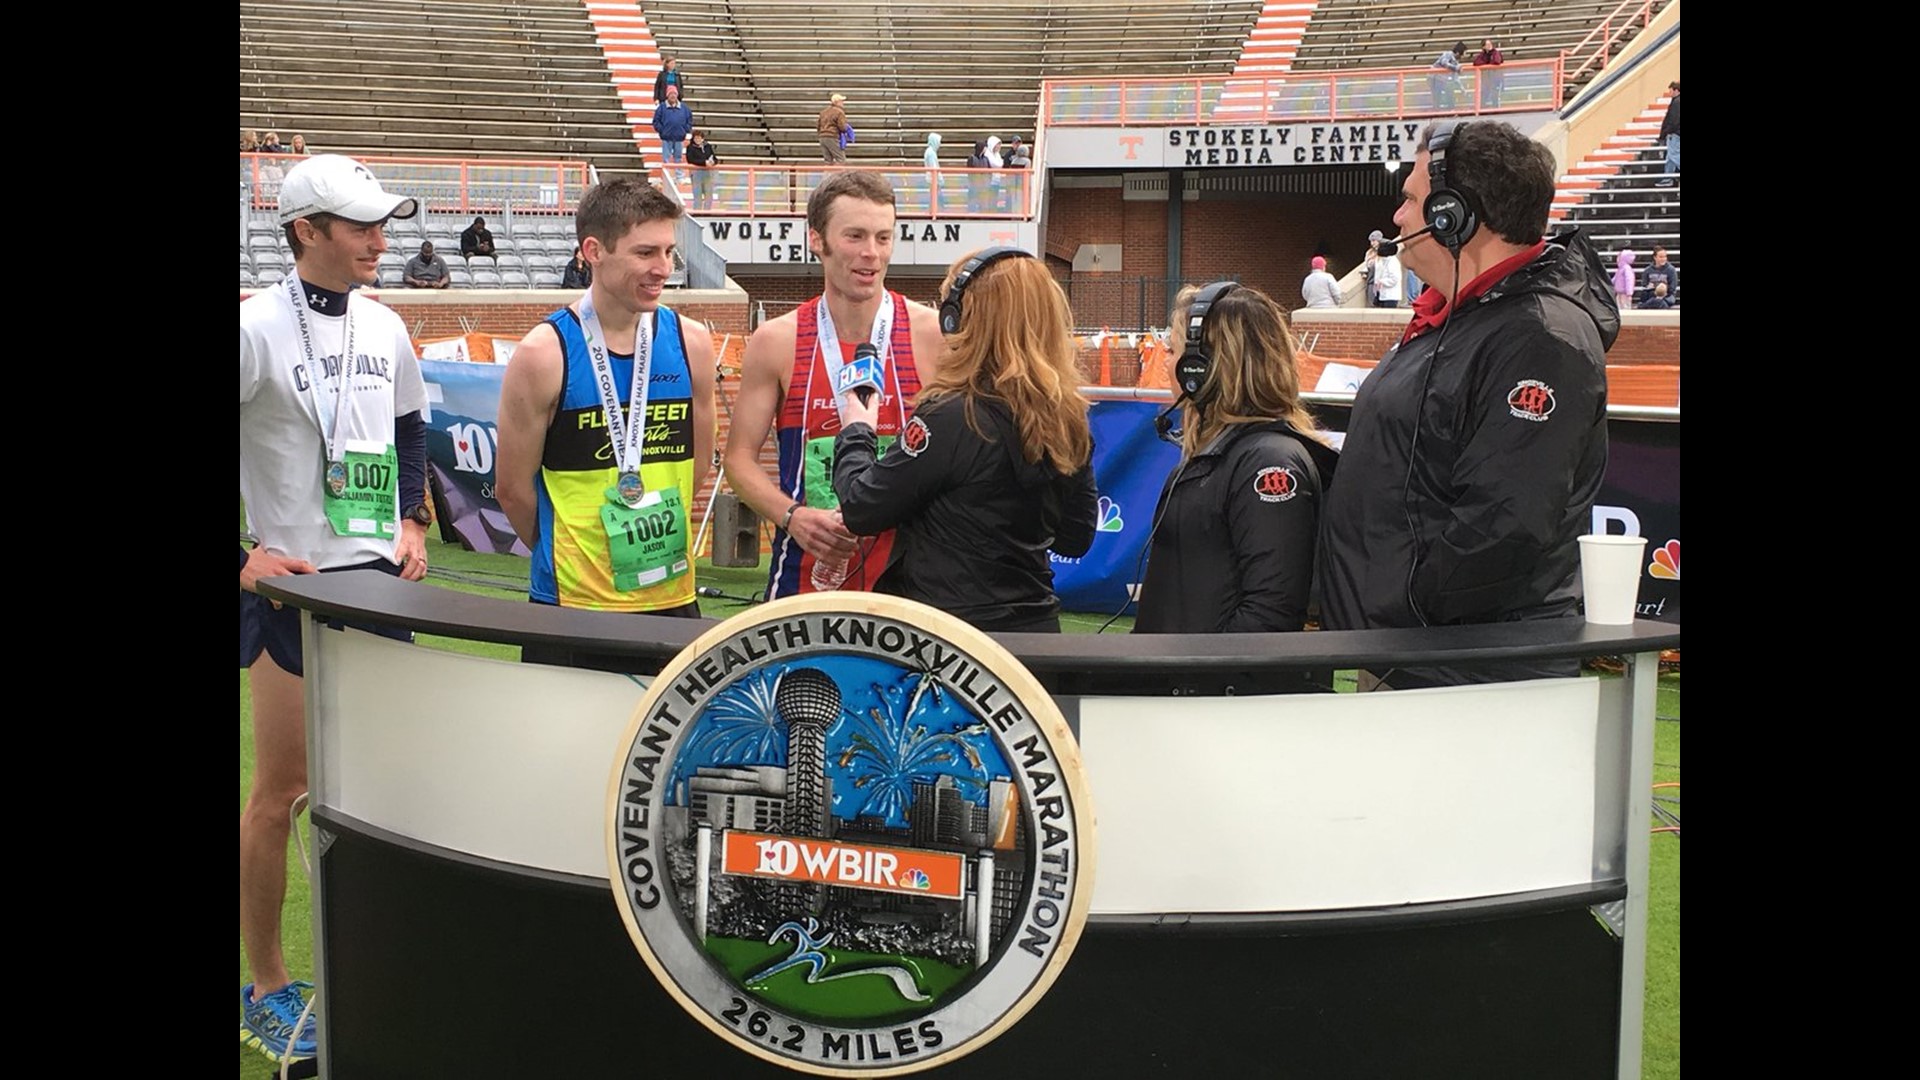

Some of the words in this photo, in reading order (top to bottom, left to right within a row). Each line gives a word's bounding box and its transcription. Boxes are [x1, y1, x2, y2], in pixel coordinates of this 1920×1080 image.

[1169, 127, 1292, 147] STOKELY
[1311, 123, 1420, 144] FAMILY
[1185, 148, 1273, 166] MEDIA
[1293, 144, 1402, 164] CENTER
[709, 222, 794, 240] WOLF
[900, 223, 961, 242] LAN
[295, 309, 314, 362] MARATHON
[638, 326, 648, 376] MARATHON
[636, 375, 645, 399] HALF
[838, 365, 856, 389] 10
[592, 346, 607, 372] 2018
[600, 374, 624, 439] COVENANT
[630, 402, 642, 448] KNOXVILLE
[447, 423, 492, 474] 10
[642, 445, 685, 457] NOXVILLE
[664, 497, 680, 509] 13.1
[609, 512, 618, 522] A
[620, 508, 678, 546] 1002
[642, 540, 666, 555] JASON
[623, 702, 682, 910] COVENANT
[674, 619, 811, 706] HEALTH
[821, 617, 1023, 733] KNOXVILLE
[1012, 734, 1078, 959] MARATHON
[721, 997, 805, 1053] 26.2
[821, 1018, 944, 1061] MILES
